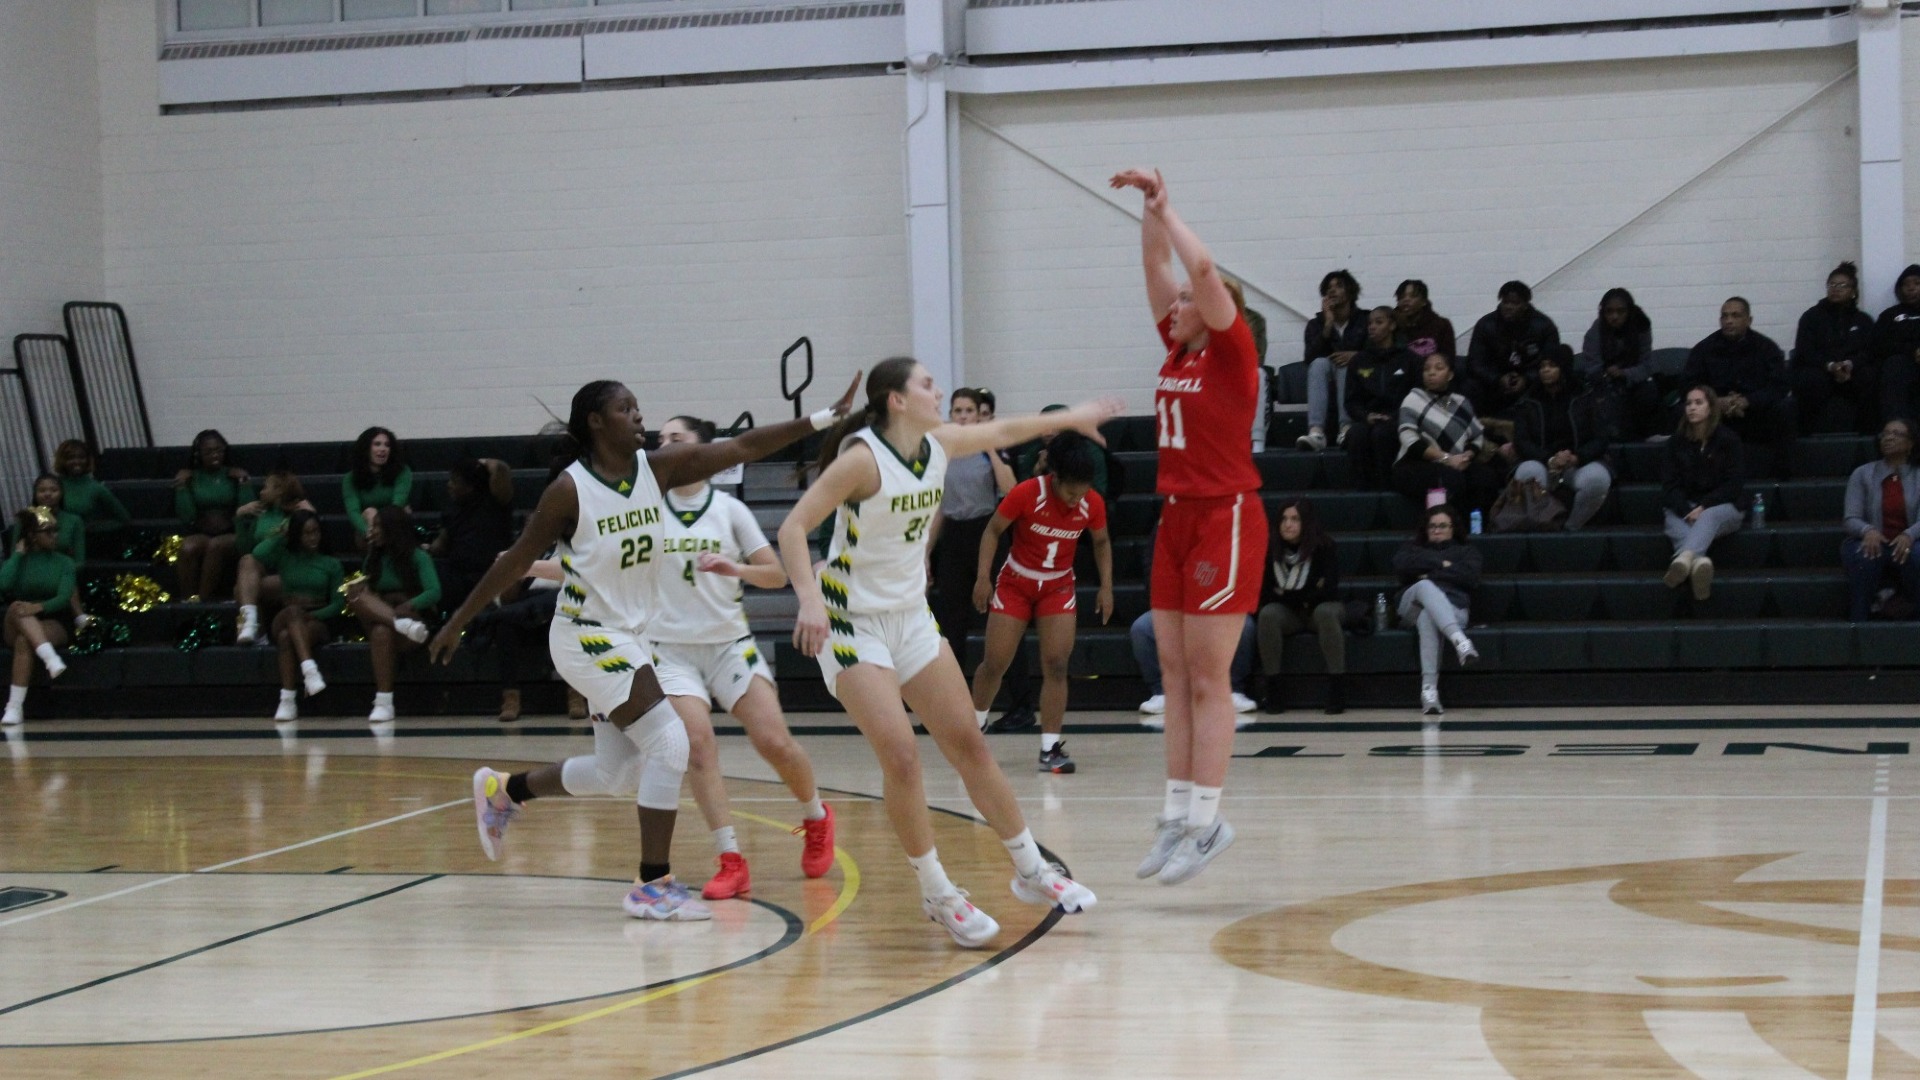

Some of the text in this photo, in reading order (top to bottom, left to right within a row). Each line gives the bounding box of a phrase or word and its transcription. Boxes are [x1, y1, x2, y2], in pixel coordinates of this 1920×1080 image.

[1158, 397, 1187, 450] 11
[620, 534, 653, 570] 22
[1041, 541, 1060, 569] 1
[683, 560, 696, 587] 4
